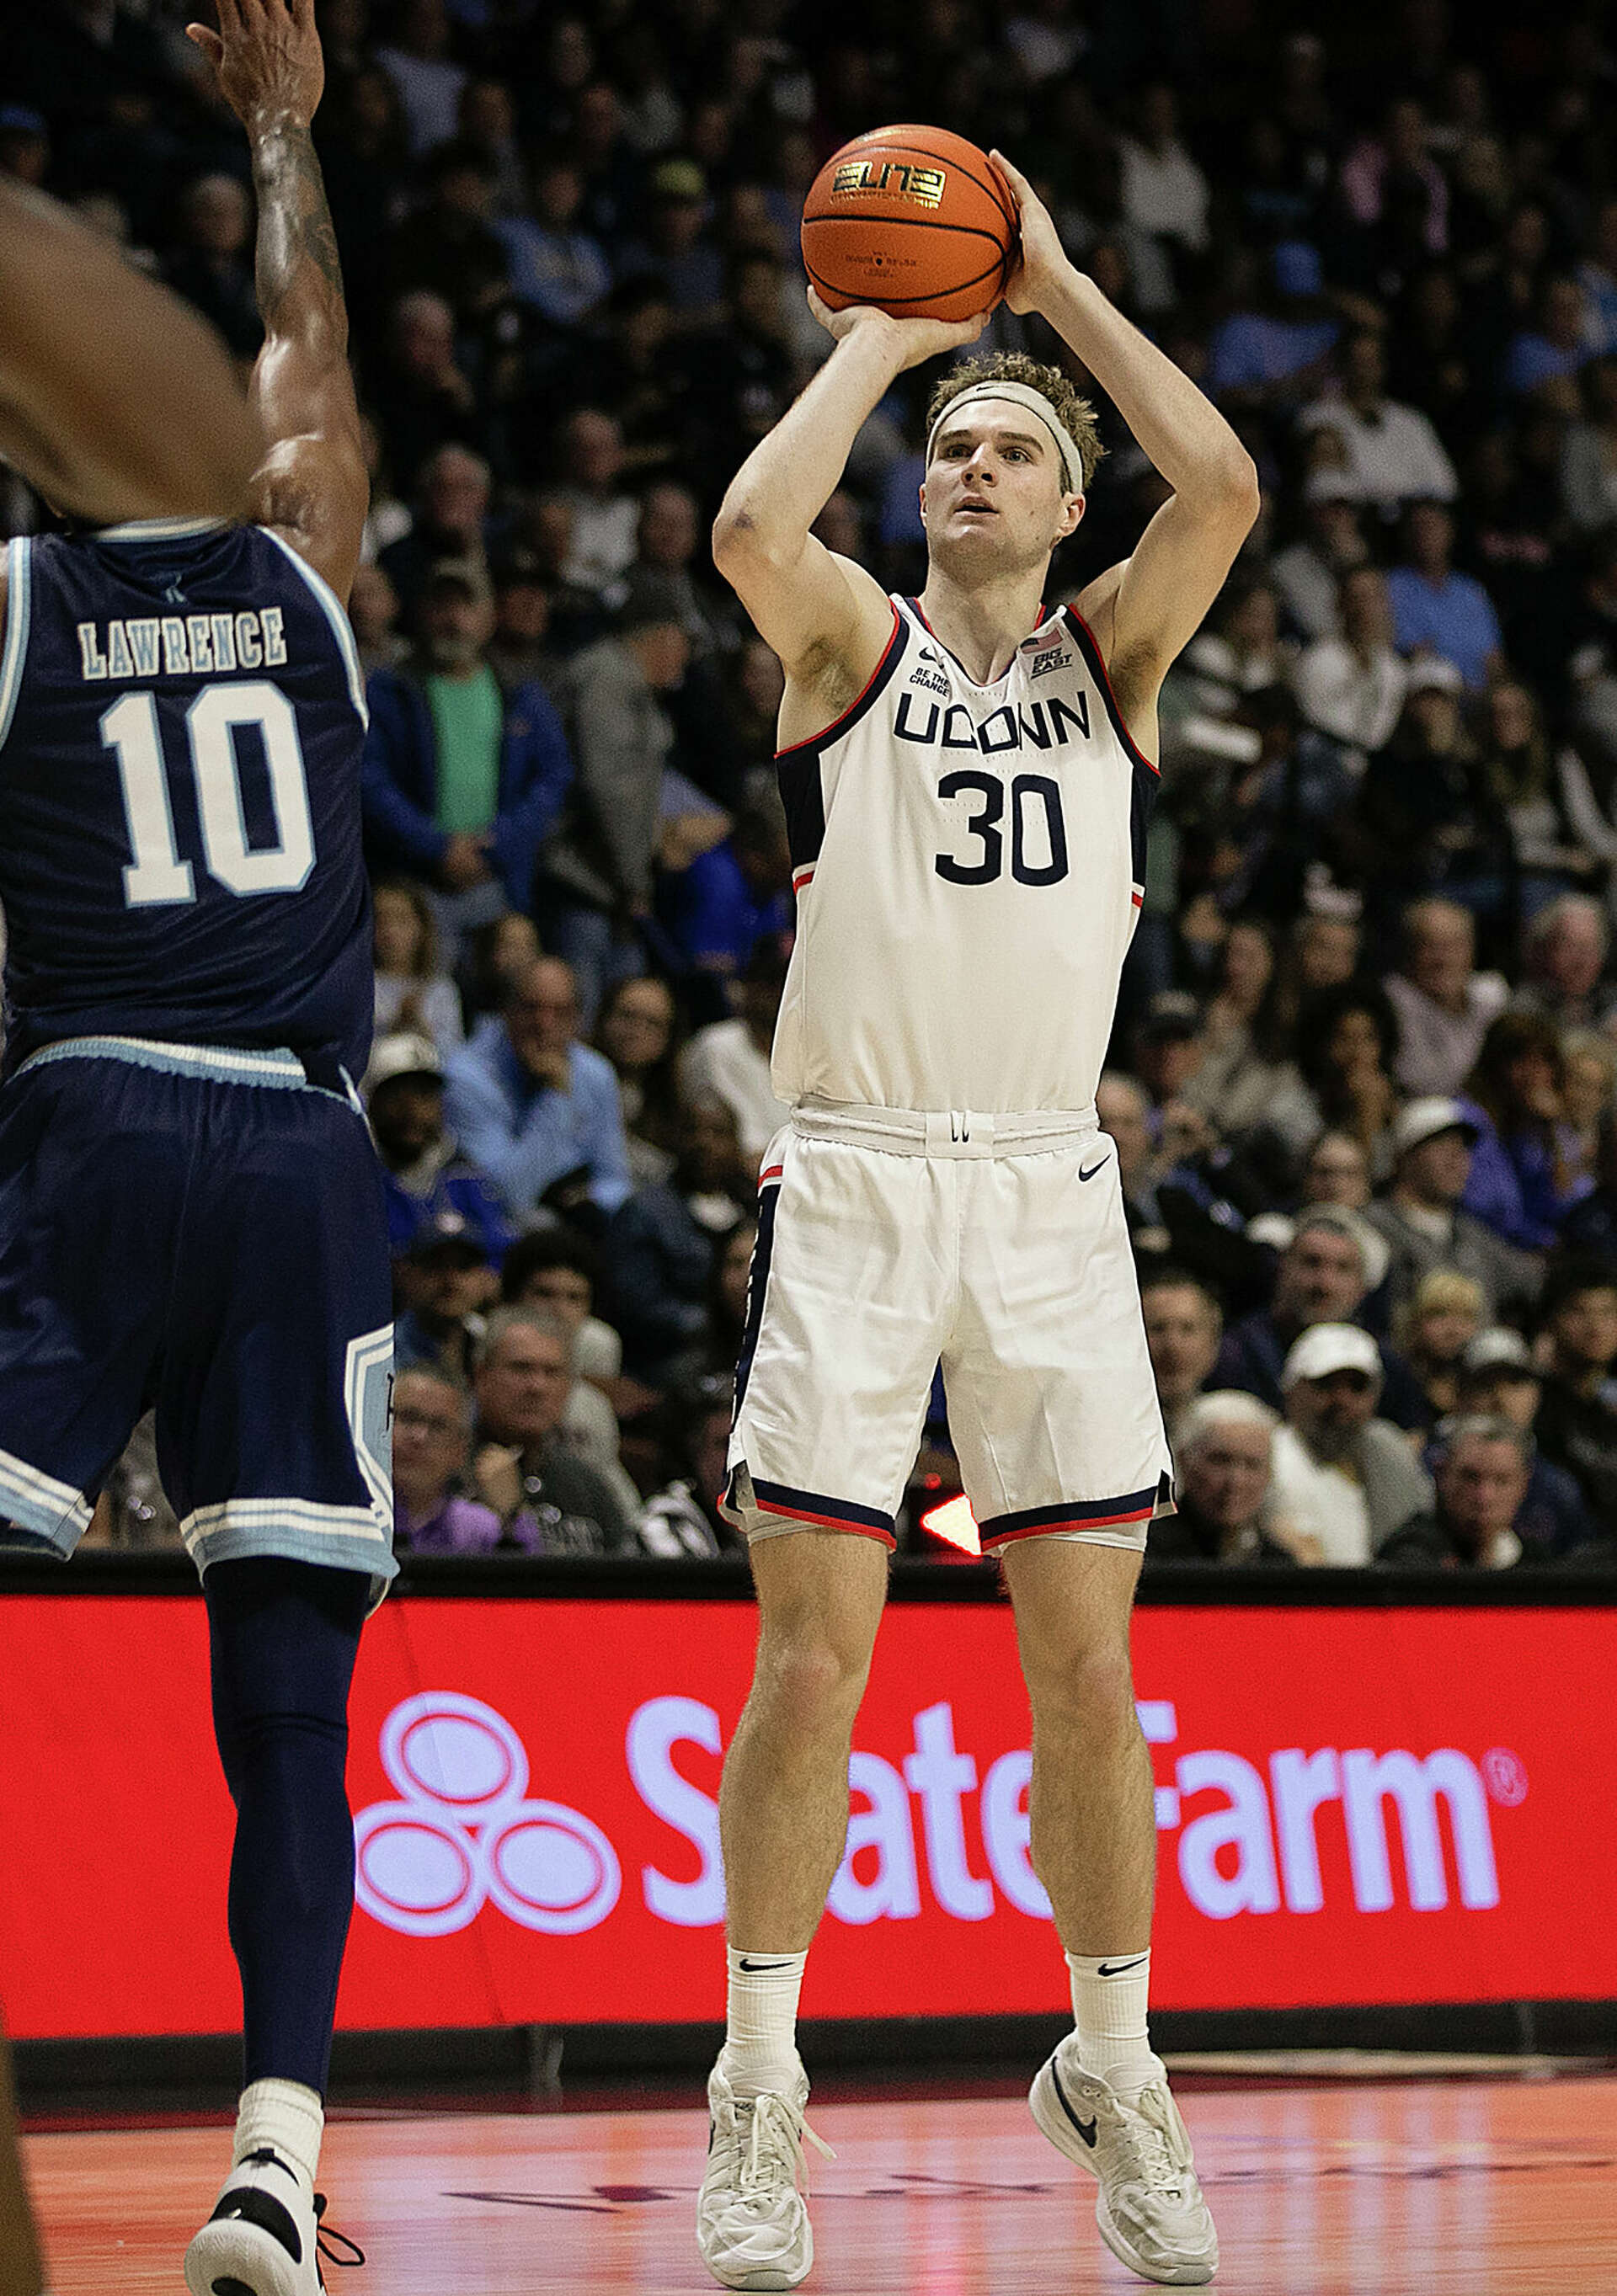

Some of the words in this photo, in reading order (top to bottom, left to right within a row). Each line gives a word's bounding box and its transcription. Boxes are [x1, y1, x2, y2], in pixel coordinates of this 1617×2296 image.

[833, 162, 946, 201] ELITE
[77, 606, 287, 680] LAWRENCE
[1033, 653, 1072, 674] EAST
[1034, 647, 1062, 664] BIG
[910, 674, 949, 698] CHANGE
[915, 667, 931, 679] BE
[932, 672, 950, 688] THE
[894, 690, 1090, 754] UCONN
[99, 679, 317, 909] 10
[935, 770, 1069, 887] 30
[626, 1695, 1054, 1927] Sate
